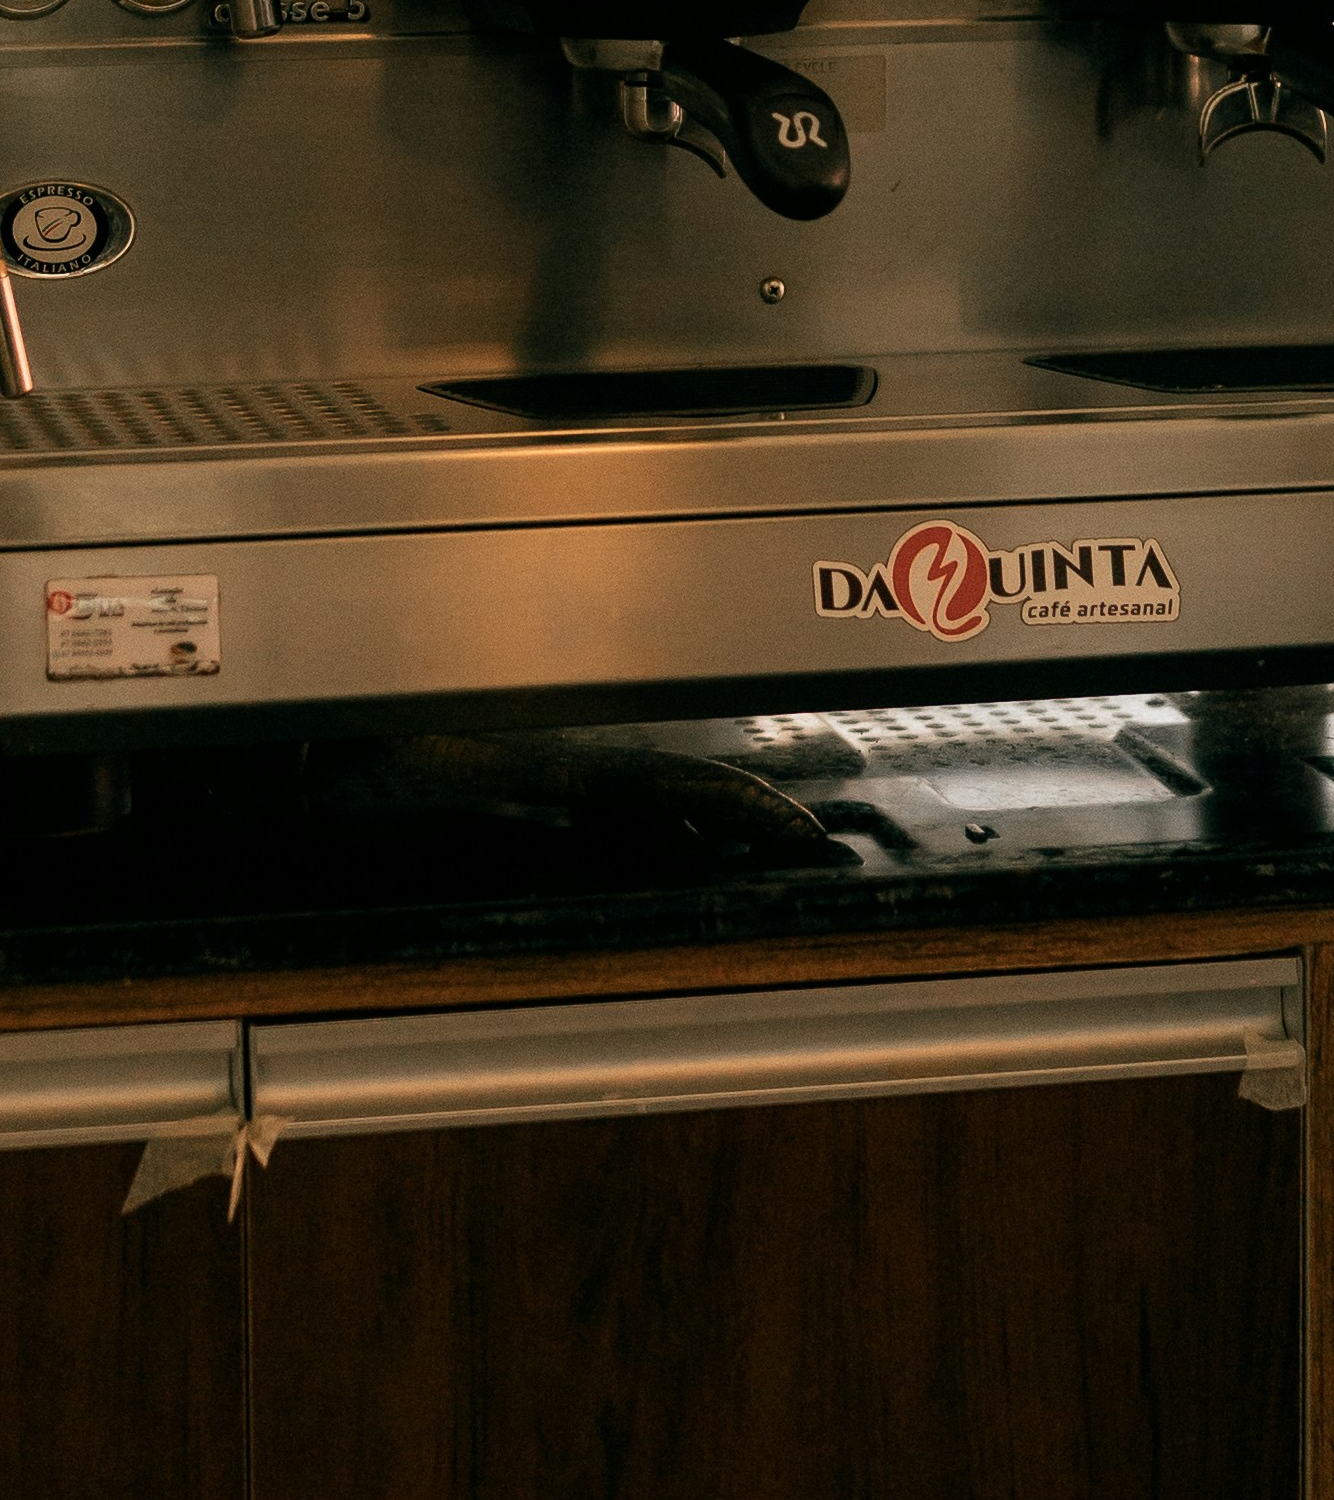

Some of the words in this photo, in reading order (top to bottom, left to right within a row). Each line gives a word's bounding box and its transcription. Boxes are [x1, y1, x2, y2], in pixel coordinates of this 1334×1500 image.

[19, 185, 94, 206] ESPRESSO
[17, 253, 92, 273] ITALIANO
[1027, 600, 1071, 619] café
[1077, 599, 1173, 618] artesanal
